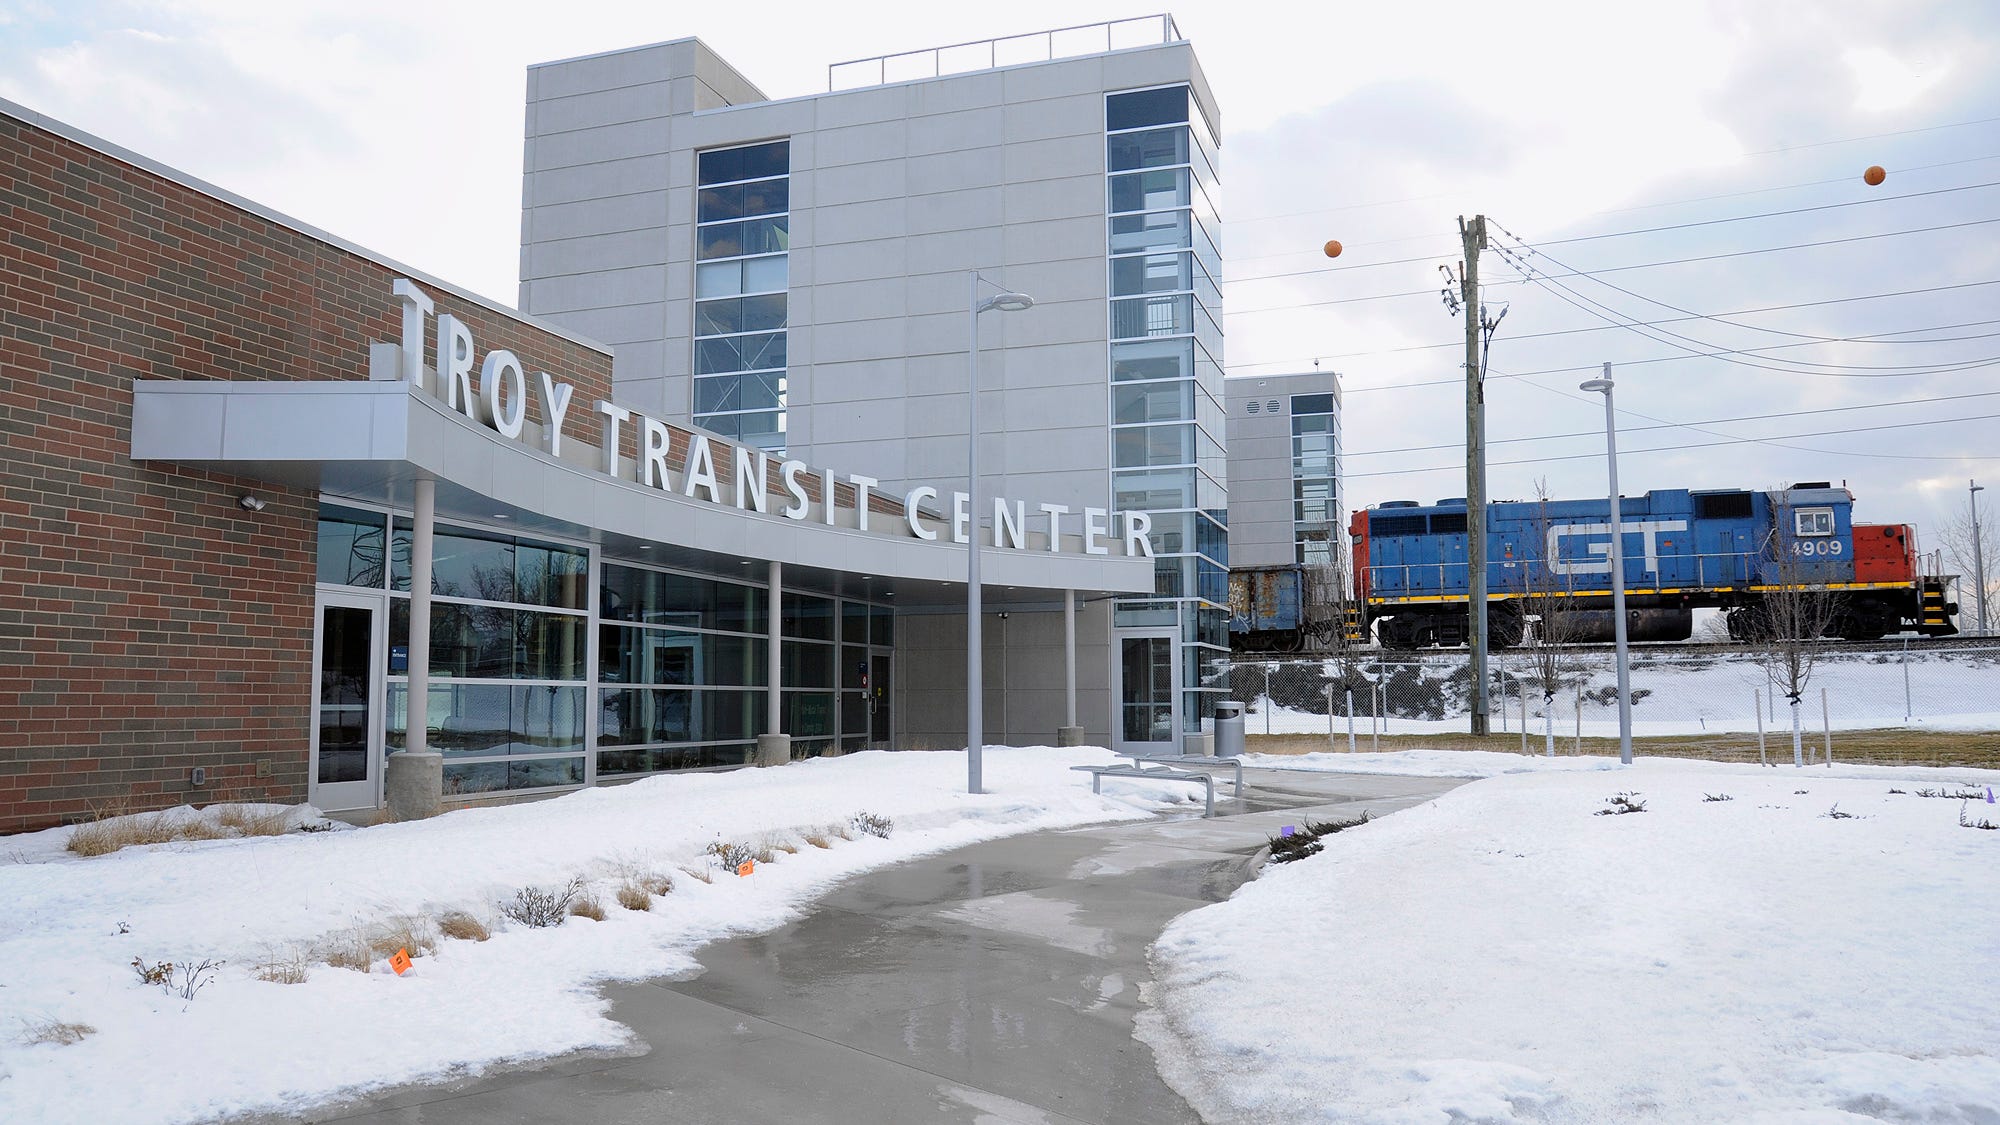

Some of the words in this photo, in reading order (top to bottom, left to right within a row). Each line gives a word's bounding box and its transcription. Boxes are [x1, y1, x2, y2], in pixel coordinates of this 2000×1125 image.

[393, 279, 574, 457] TROY
[594, 400, 878, 531] TRANSIT
[904, 486, 1154, 557] CENTER
[1547, 519, 1687, 575] GT
